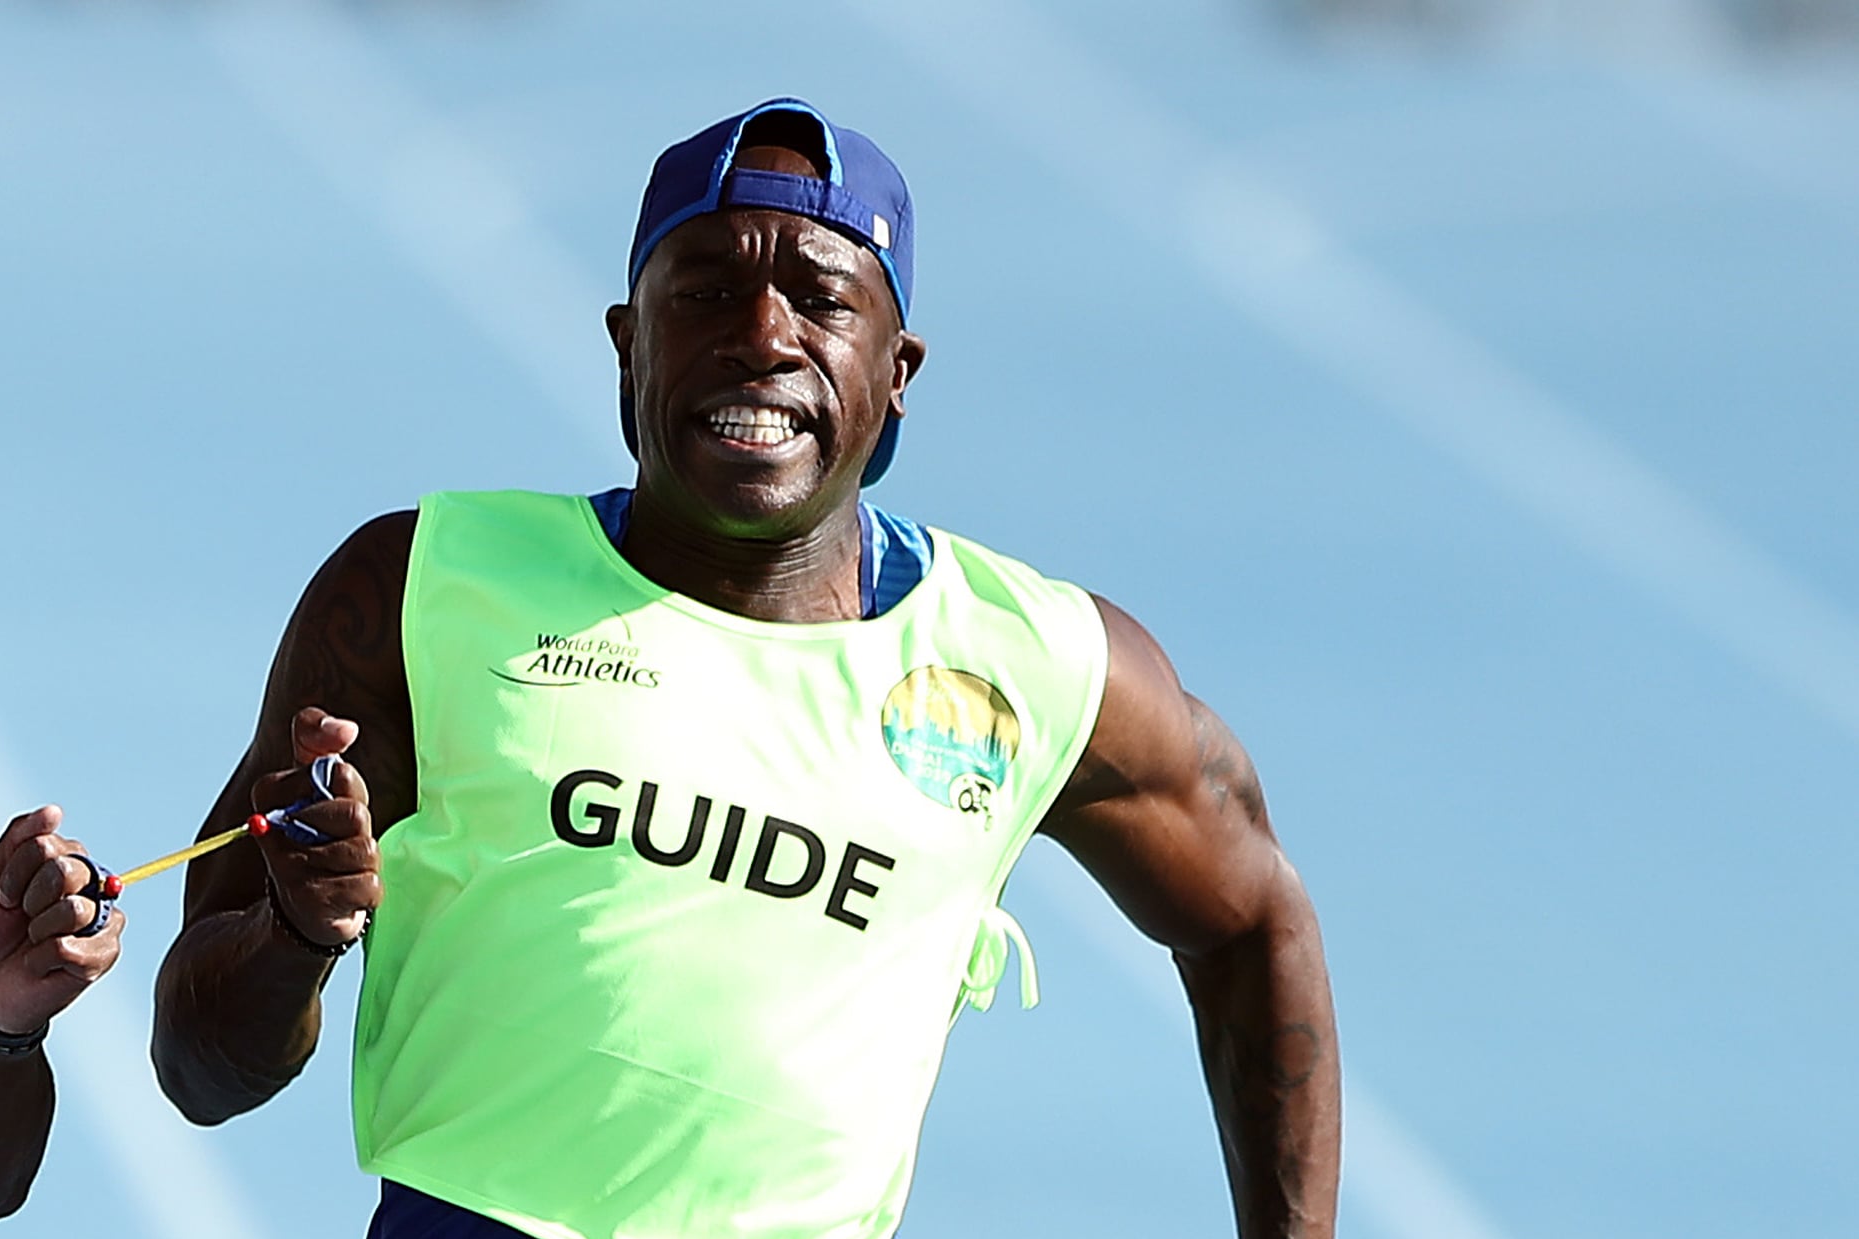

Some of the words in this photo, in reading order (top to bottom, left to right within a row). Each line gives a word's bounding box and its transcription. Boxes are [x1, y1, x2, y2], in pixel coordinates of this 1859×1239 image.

[537, 633, 592, 652] World
[597, 640, 639, 657] Para
[527, 653, 661, 688] Athletics
[550, 769, 895, 931] GUIDE
